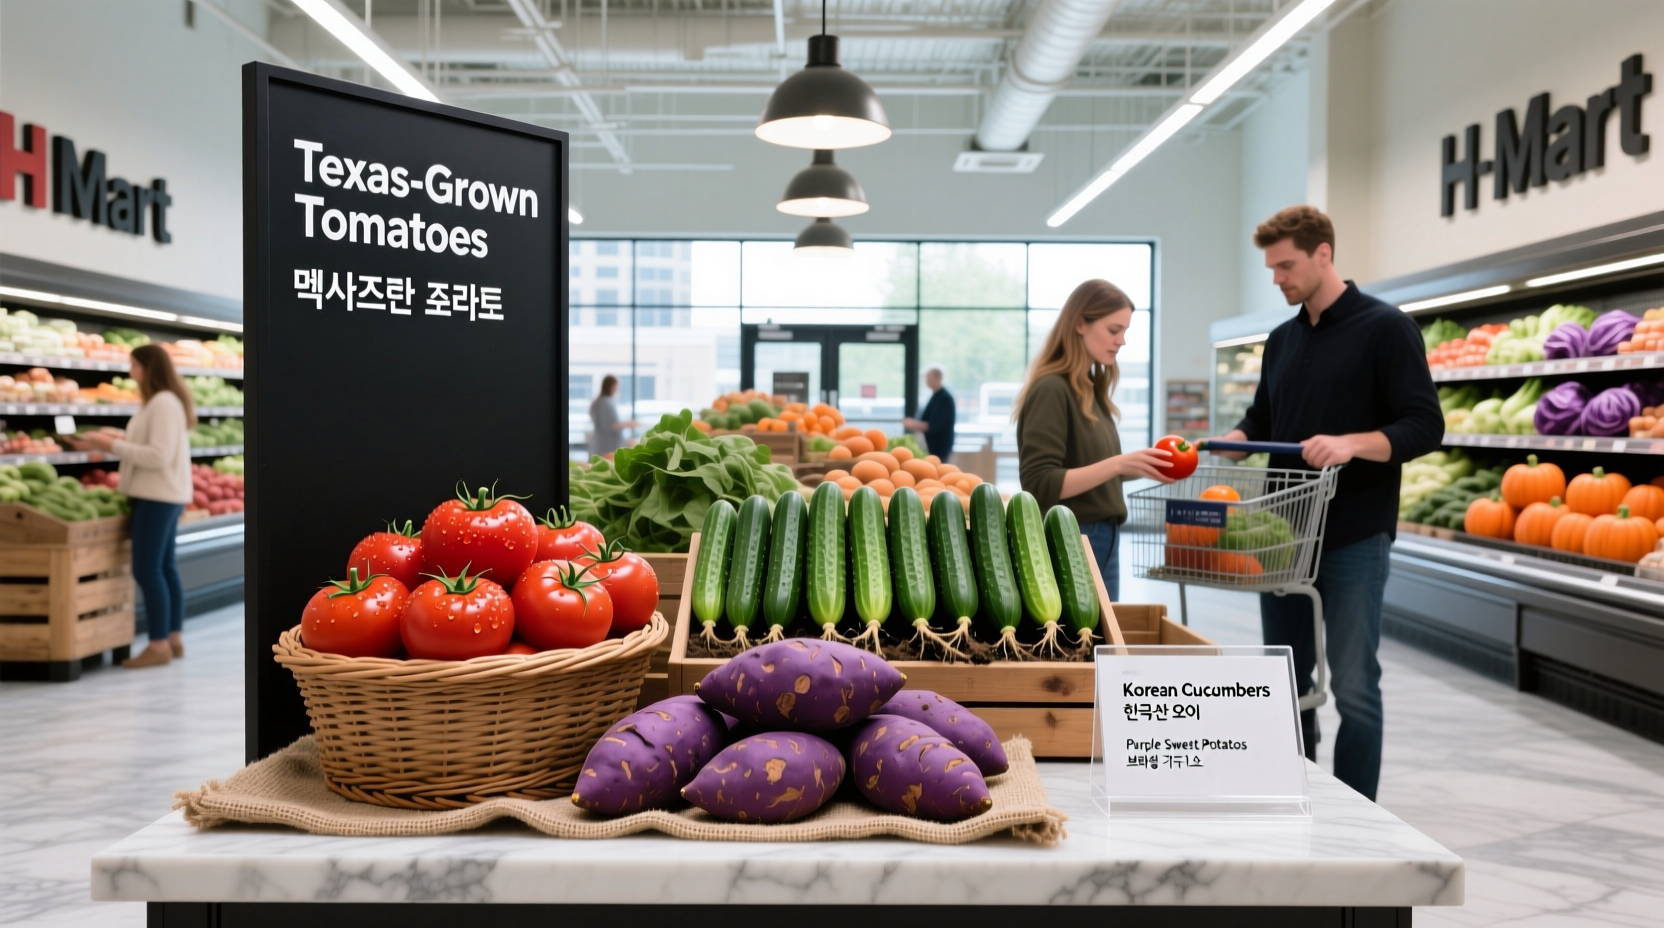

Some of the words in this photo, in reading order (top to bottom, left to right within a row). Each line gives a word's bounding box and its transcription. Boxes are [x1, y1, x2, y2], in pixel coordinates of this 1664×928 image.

[1441, 54, 1652, 218] H-Mart
[52, 135, 171, 243] Mart
[294, 139, 538, 218] Texas-Grown
[295, 193, 488, 258] Tomatoes
[1123, 682, 1178, 697] Korean
[1181, 682, 1271, 697] Cucumbers
[1172, 704, 1200, 720] 오이
